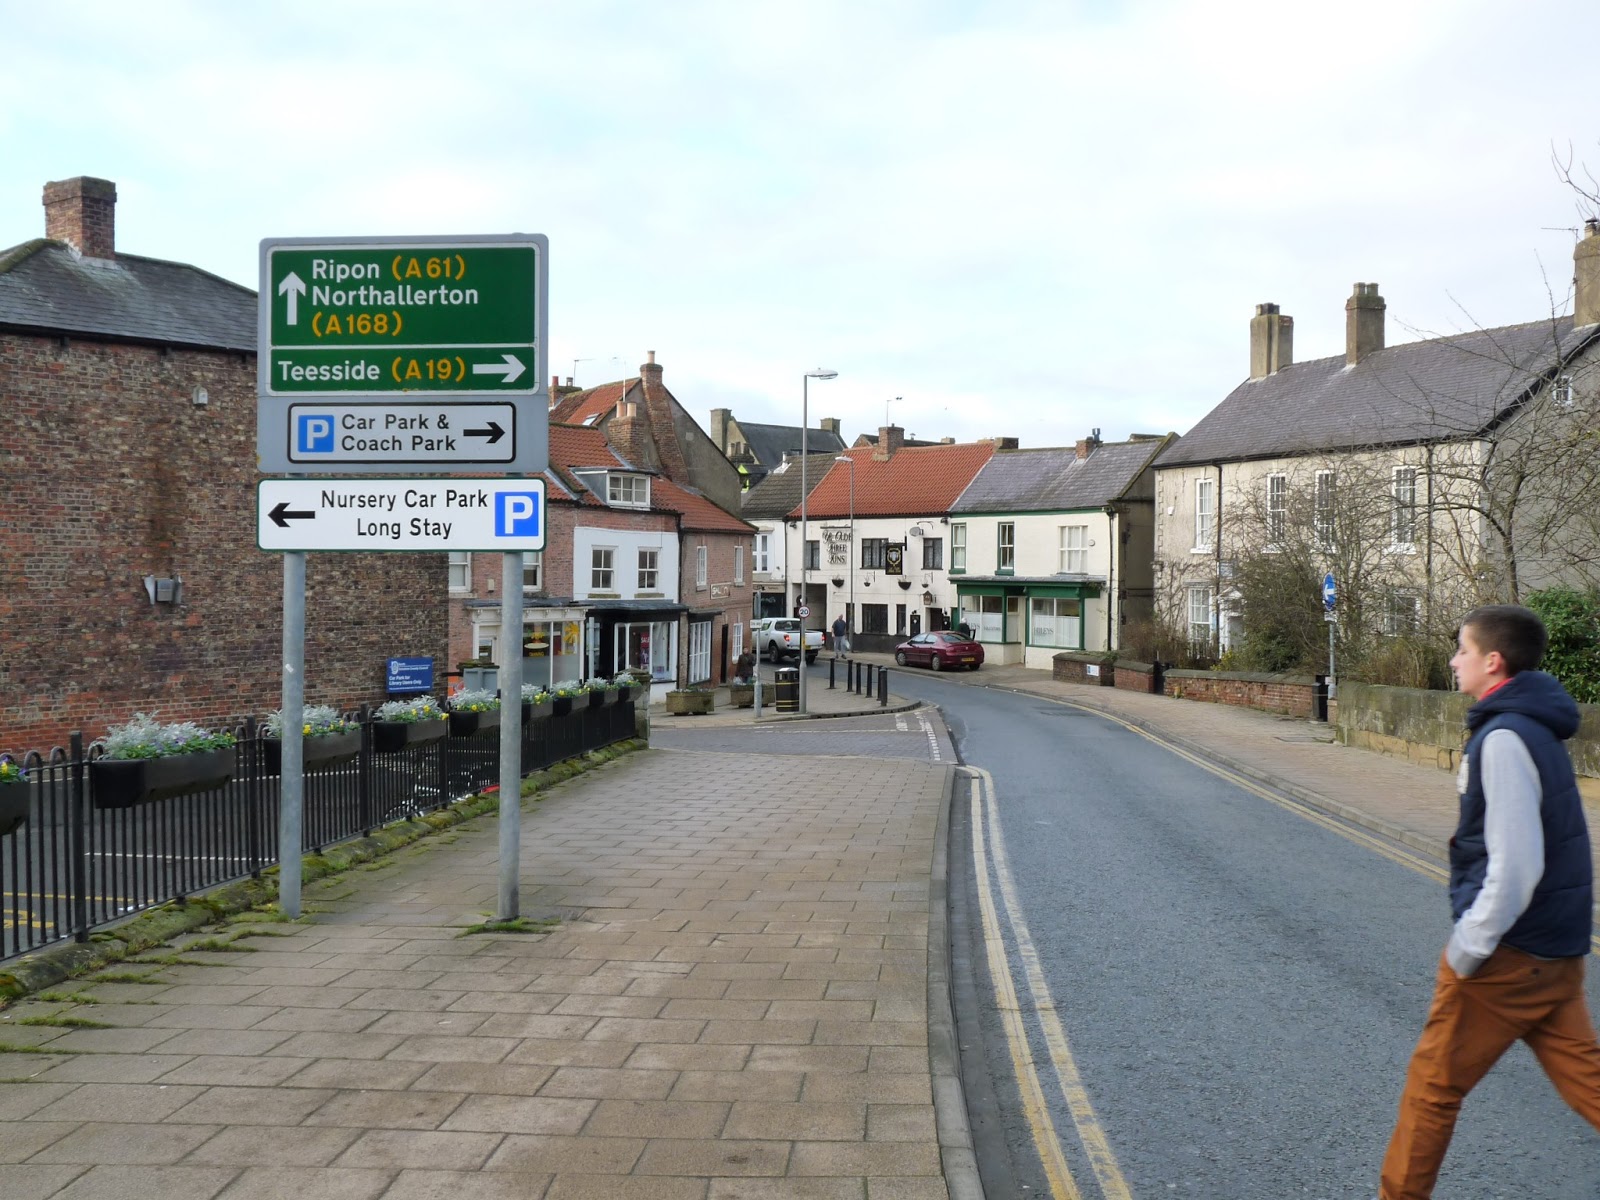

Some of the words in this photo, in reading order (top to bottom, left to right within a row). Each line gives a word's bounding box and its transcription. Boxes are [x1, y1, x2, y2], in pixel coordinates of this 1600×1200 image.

[312, 259, 380, 283] Ripon
[391, 254, 465, 281] (A61)
[312, 284, 479, 306] Northallerton
[312, 310, 402, 337] (A168)
[278, 360, 380, 382] Teesside
[391, 356, 465, 382] (A19)
[306, 419, 329, 449] P
[342, 414, 376, 430] Car
[384, 414, 430, 430] Park
[436, 414, 450, 430] &
[341, 435, 402, 452] Coach
[411, 435, 457, 451] Park
[321, 490, 397, 512] Nursery
[404, 489, 437, 508] Car
[446, 489, 489, 508] Park
[504, 495, 534, 534] P
[357, 518, 402, 539] Long
[409, 517, 453, 539] Stay
